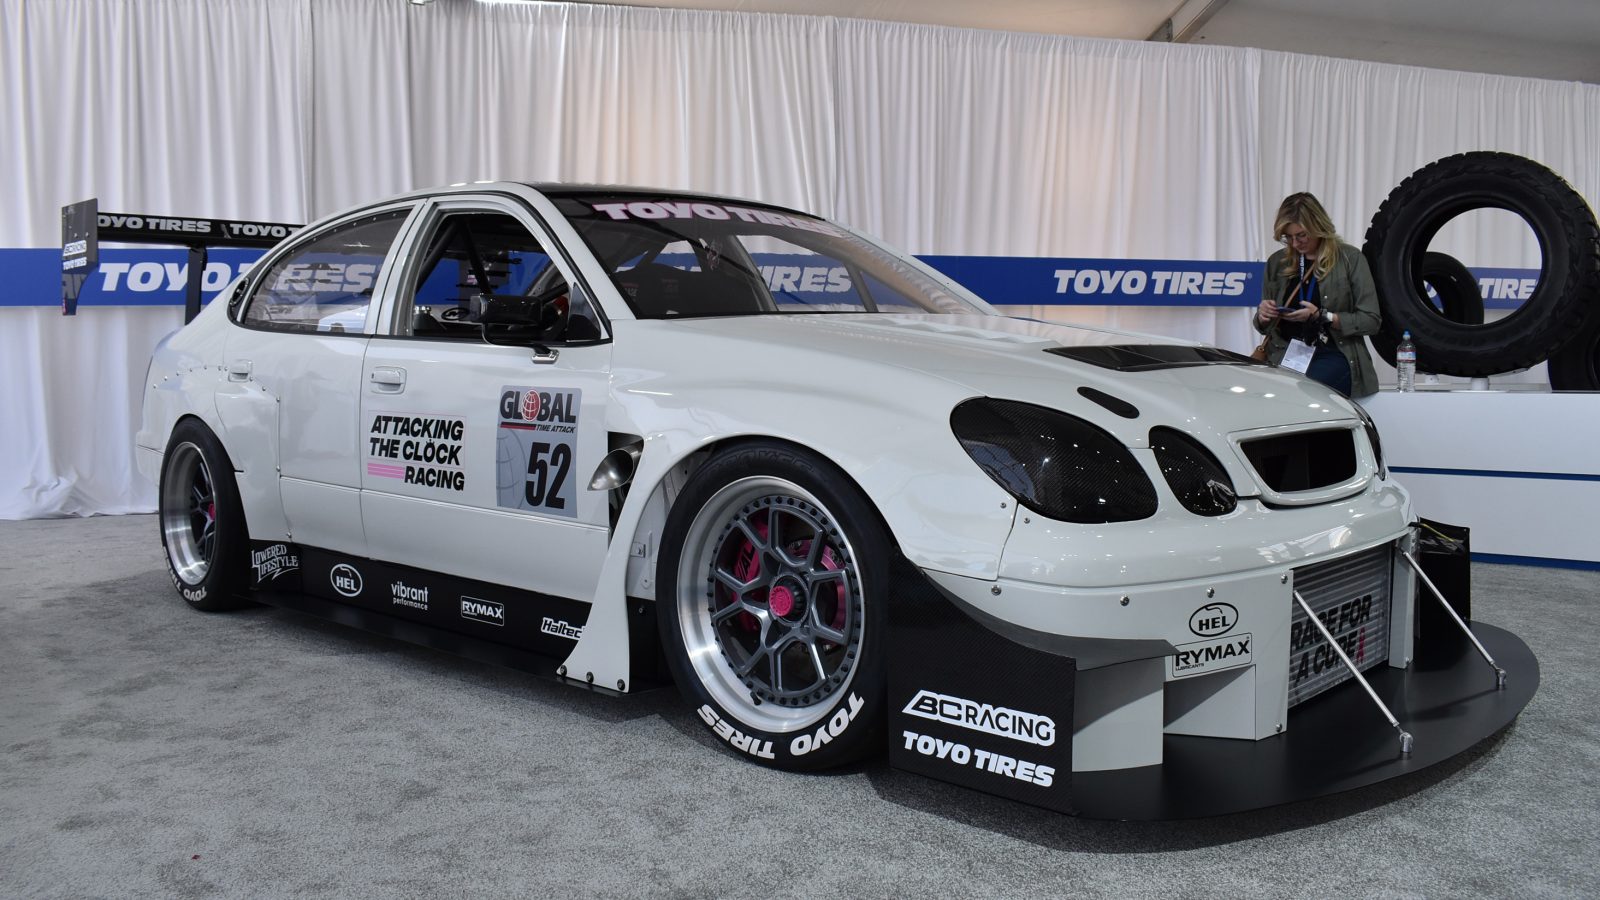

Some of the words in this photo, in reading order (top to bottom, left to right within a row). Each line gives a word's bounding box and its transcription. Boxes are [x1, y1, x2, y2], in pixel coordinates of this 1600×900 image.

[98, 216, 144, 229] OYO
[146, 218, 211, 233] TIRES
[230, 223, 286, 238] TOYO
[591, 202, 729, 221] TOYO
[726, 205, 843, 238] TIRES
[99, 262, 232, 292] TOYO
[758, 265, 852, 293] IRES
[1054, 269, 1147, 295] TOYO
[1151, 271, 1247, 296] TIRES
[1478, 277, 1538, 300] TIRE
[500, 389, 576, 423] GLOBAL
[371, 415, 464, 441] ATTACKING
[537, 424, 550, 432] TIME
[551, 425, 576, 433] ATTACK
[370, 437, 399, 459] THE
[402, 439, 463, 466] CLOCK
[404, 465, 465, 491] RACING
[525, 441, 571, 509] 52
[251, 544, 287, 568] LOWERED
[183, 586, 207, 601] TOYO
[336, 575, 357, 591] HEL
[391, 581, 428, 602] vibrant
[393, 597, 428, 610] performance
[462, 601, 503, 619] RYMAX
[1339, 595, 1372, 632] FOR
[541, 617, 584, 640] Haltec
[1198, 616, 1230, 631] HEL
[1175, 640, 1250, 667] RYMAX
[1295, 652, 1309, 684] A
[697, 704, 775, 759] TIRES
[790, 691, 865, 756] TOYO
[903, 730, 971, 765] TOYO
[974, 749, 1056, 787] TIRES
